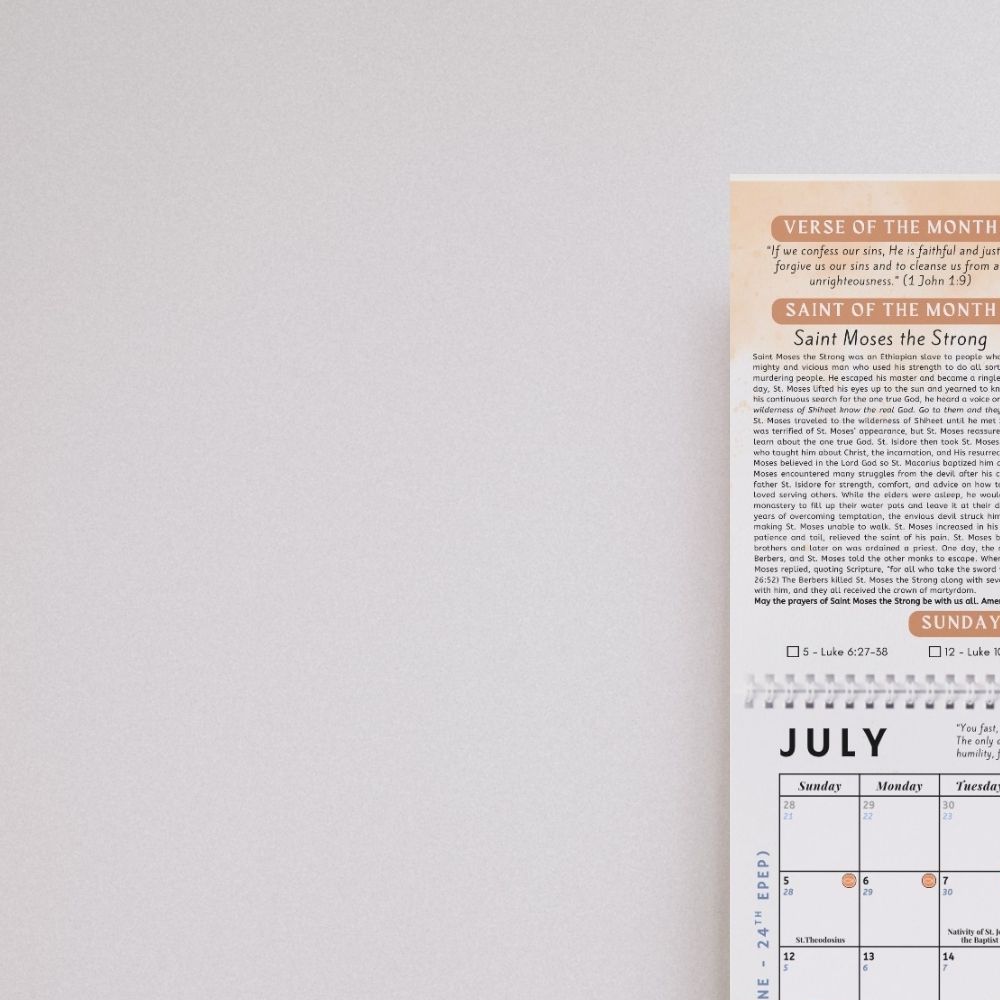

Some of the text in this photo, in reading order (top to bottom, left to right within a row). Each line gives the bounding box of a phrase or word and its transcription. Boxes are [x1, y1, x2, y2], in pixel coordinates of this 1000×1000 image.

[783, 219, 997, 235] VERSE OF THE MONTH
[801, 244, 839, 259] confess
[862, 246, 885, 257] sins,
[888, 244, 904, 256] He
[915, 244, 956, 259] faithful
[959, 244, 980, 256] and
[773, 259, 812, 275] forgive
[850, 261, 870, 271] sins
[872, 260, 892, 271] and
[896, 262, 908, 271] to
[909, 259, 947, 271] cleanse
[962, 259, 990, 275] from
[917, 274, 945, 287] John
[785, 302, 996, 317] SAINT OF THE MONTH
[793, 328, 988, 352] Saint Moses the Strong
[754, 597, 771, 607] May
[772, 597, 786, 605] the
[787, 598, 818, 607] prayers
[819, 596, 829, 605] of
[830, 597, 852, 605] Saint
[878, 596, 893, 605] the
[894, 597, 921, 607] Strong
[922, 597, 933, 605] be
[934, 596, 952, 605] with
[965, 596, 979, 605] all.
[921, 614, 1000, 630] SUNDAY
[802, 647, 809, 657] 5
[820, 646, 844, 657] Luke
[944, 647, 955, 657] 12
[967, 646, 991, 657] Luke
[978, 722, 999, 736] fast,
[779, 727, 888, 758] JULY
[797, 780, 842, 793] Sunday
[876, 780, 923, 793] Monday
[756, 850, 770, 900] EPEP)
[783, 876, 790, 886] 5
[942, 876, 949, 886] 7
[783, 951, 795, 961] 12
[942, 952, 955, 961] 14
